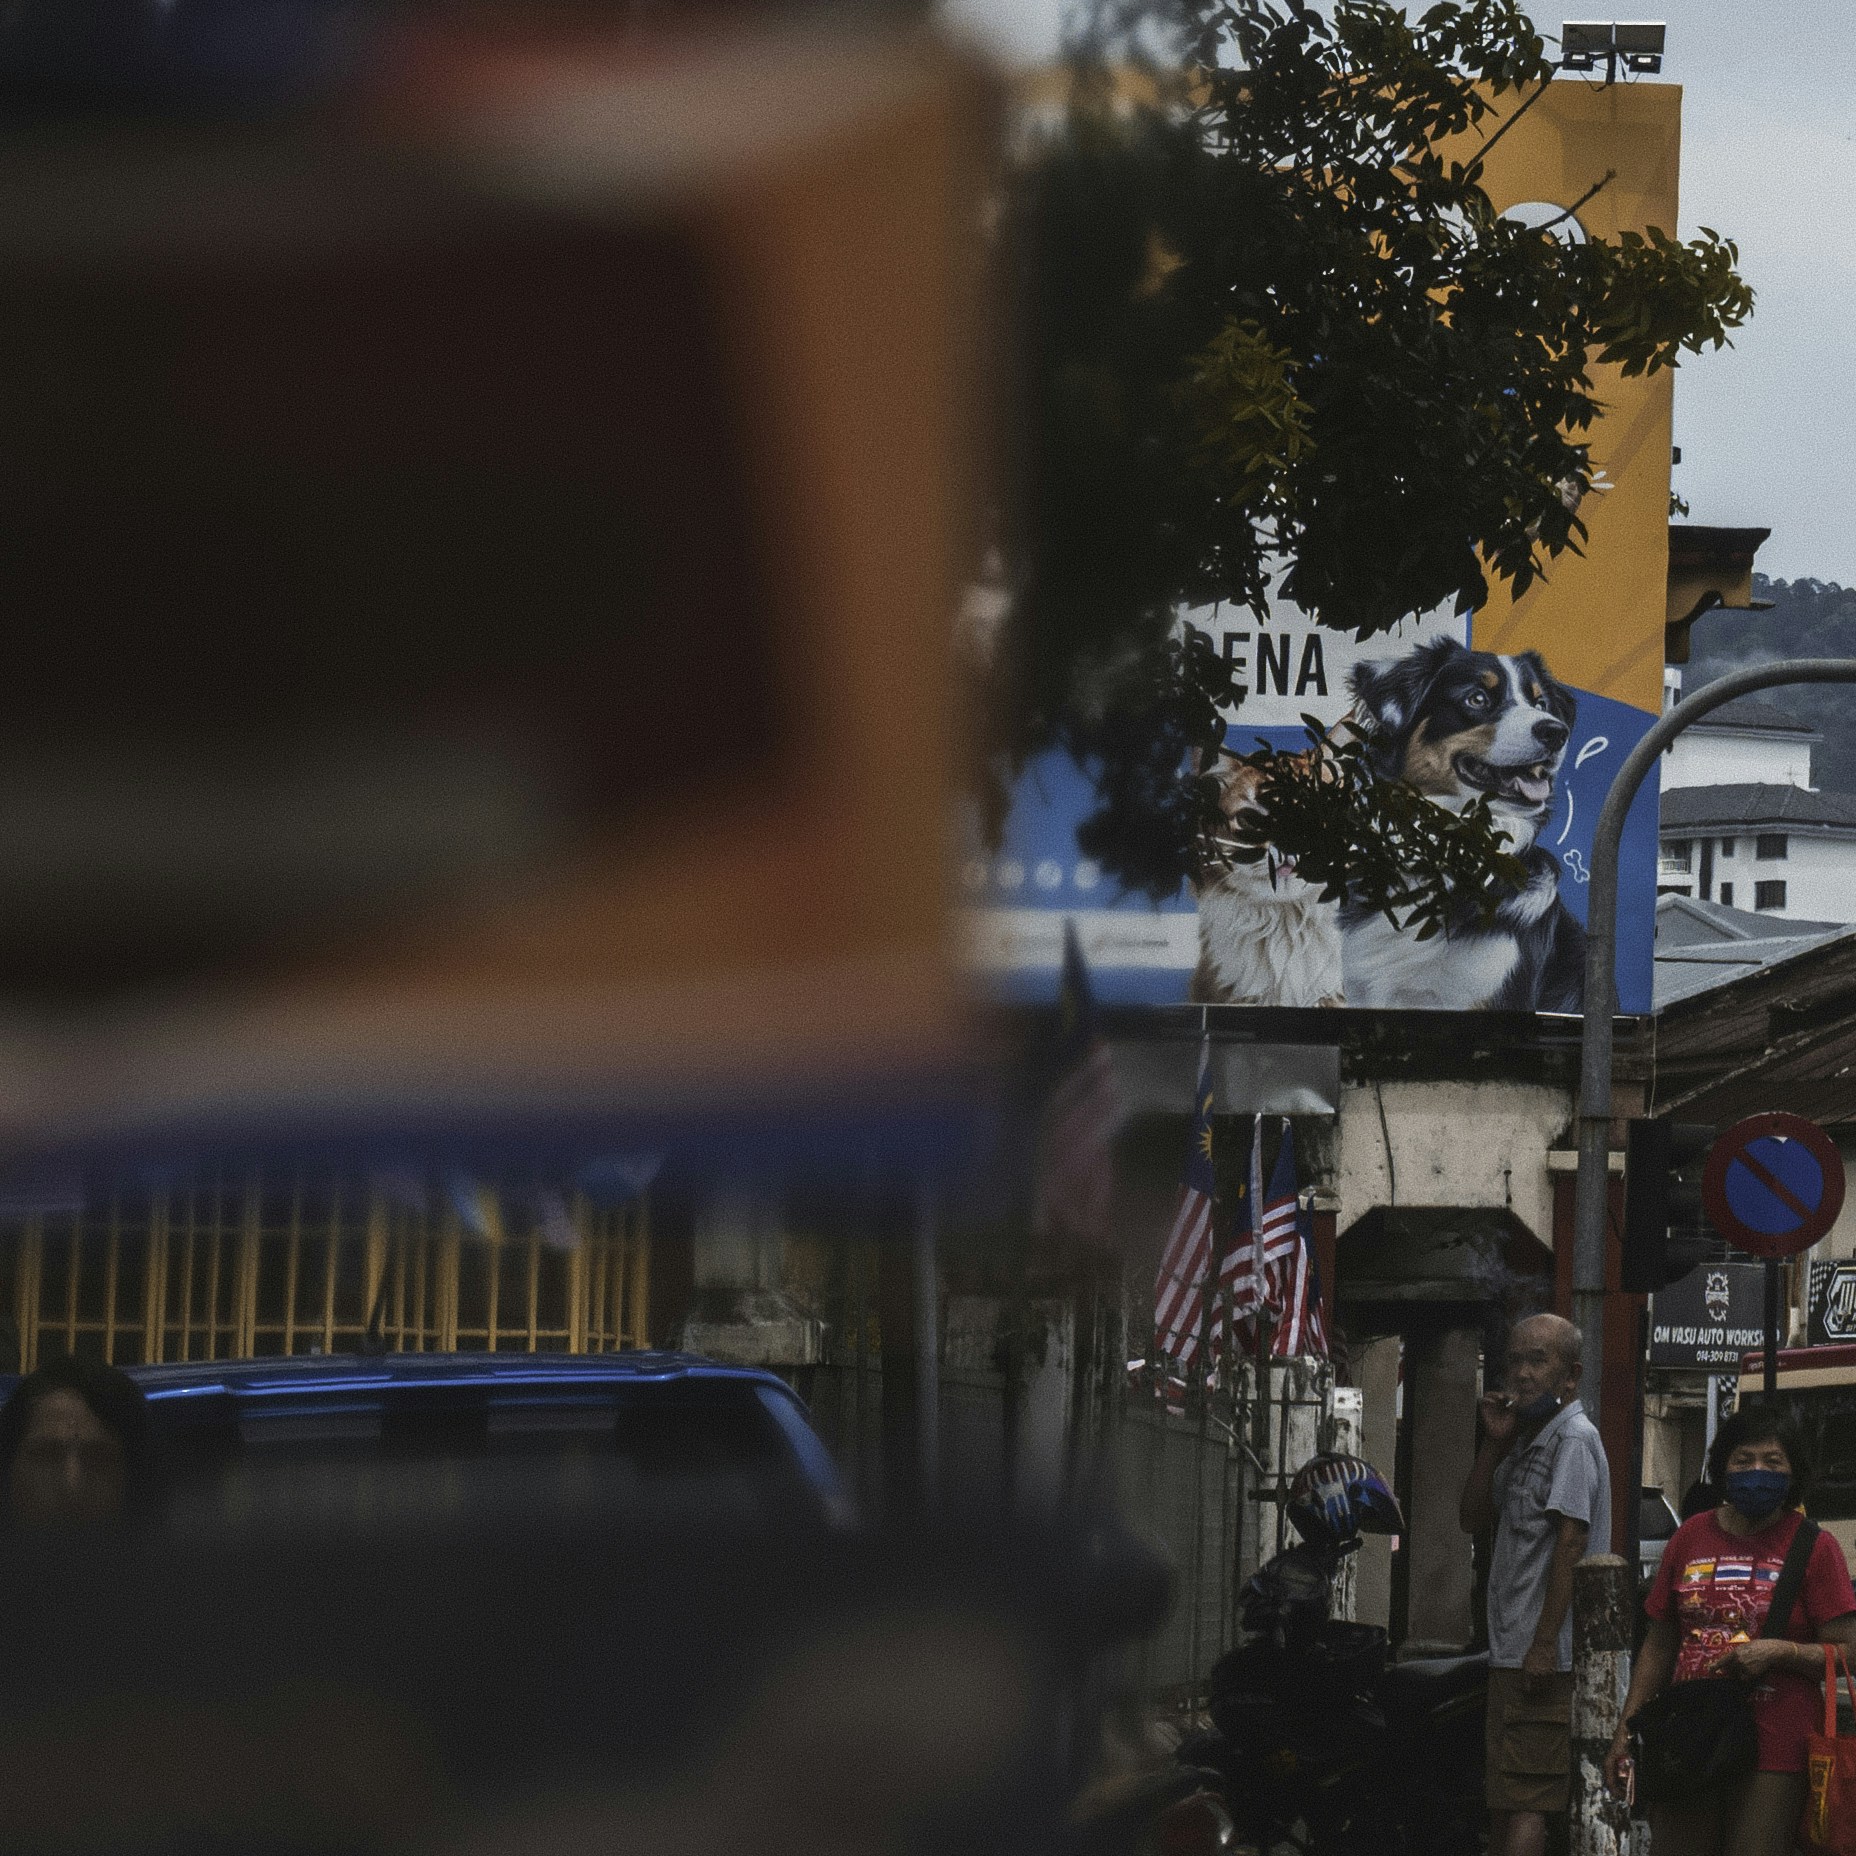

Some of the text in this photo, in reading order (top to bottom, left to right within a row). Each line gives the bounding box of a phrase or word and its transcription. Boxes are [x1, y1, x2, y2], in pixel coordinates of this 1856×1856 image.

[1653, 1326, 1670, 1344] OM
[1671, 1327, 1697, 1345] VASU
[1697, 1327, 1724, 1346] AUTO
